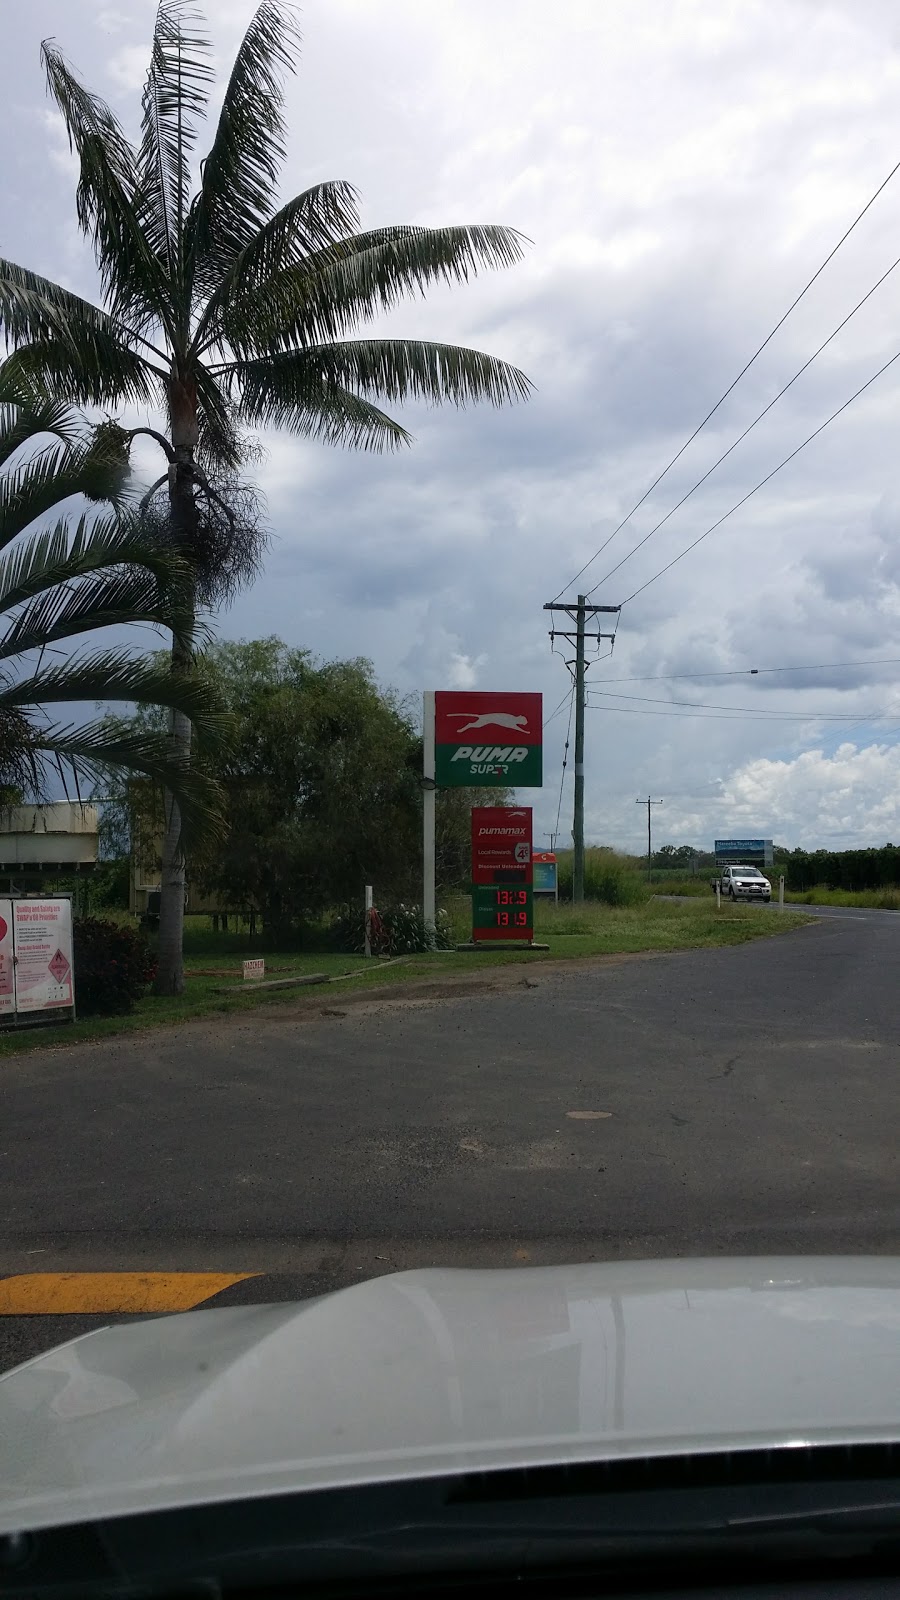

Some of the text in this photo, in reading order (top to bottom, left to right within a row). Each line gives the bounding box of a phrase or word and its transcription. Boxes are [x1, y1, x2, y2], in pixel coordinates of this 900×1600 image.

[450, 746, 529, 762] PUMA
[470, 764, 509, 774] SUPER
[478, 827, 527, 837] pumamax
